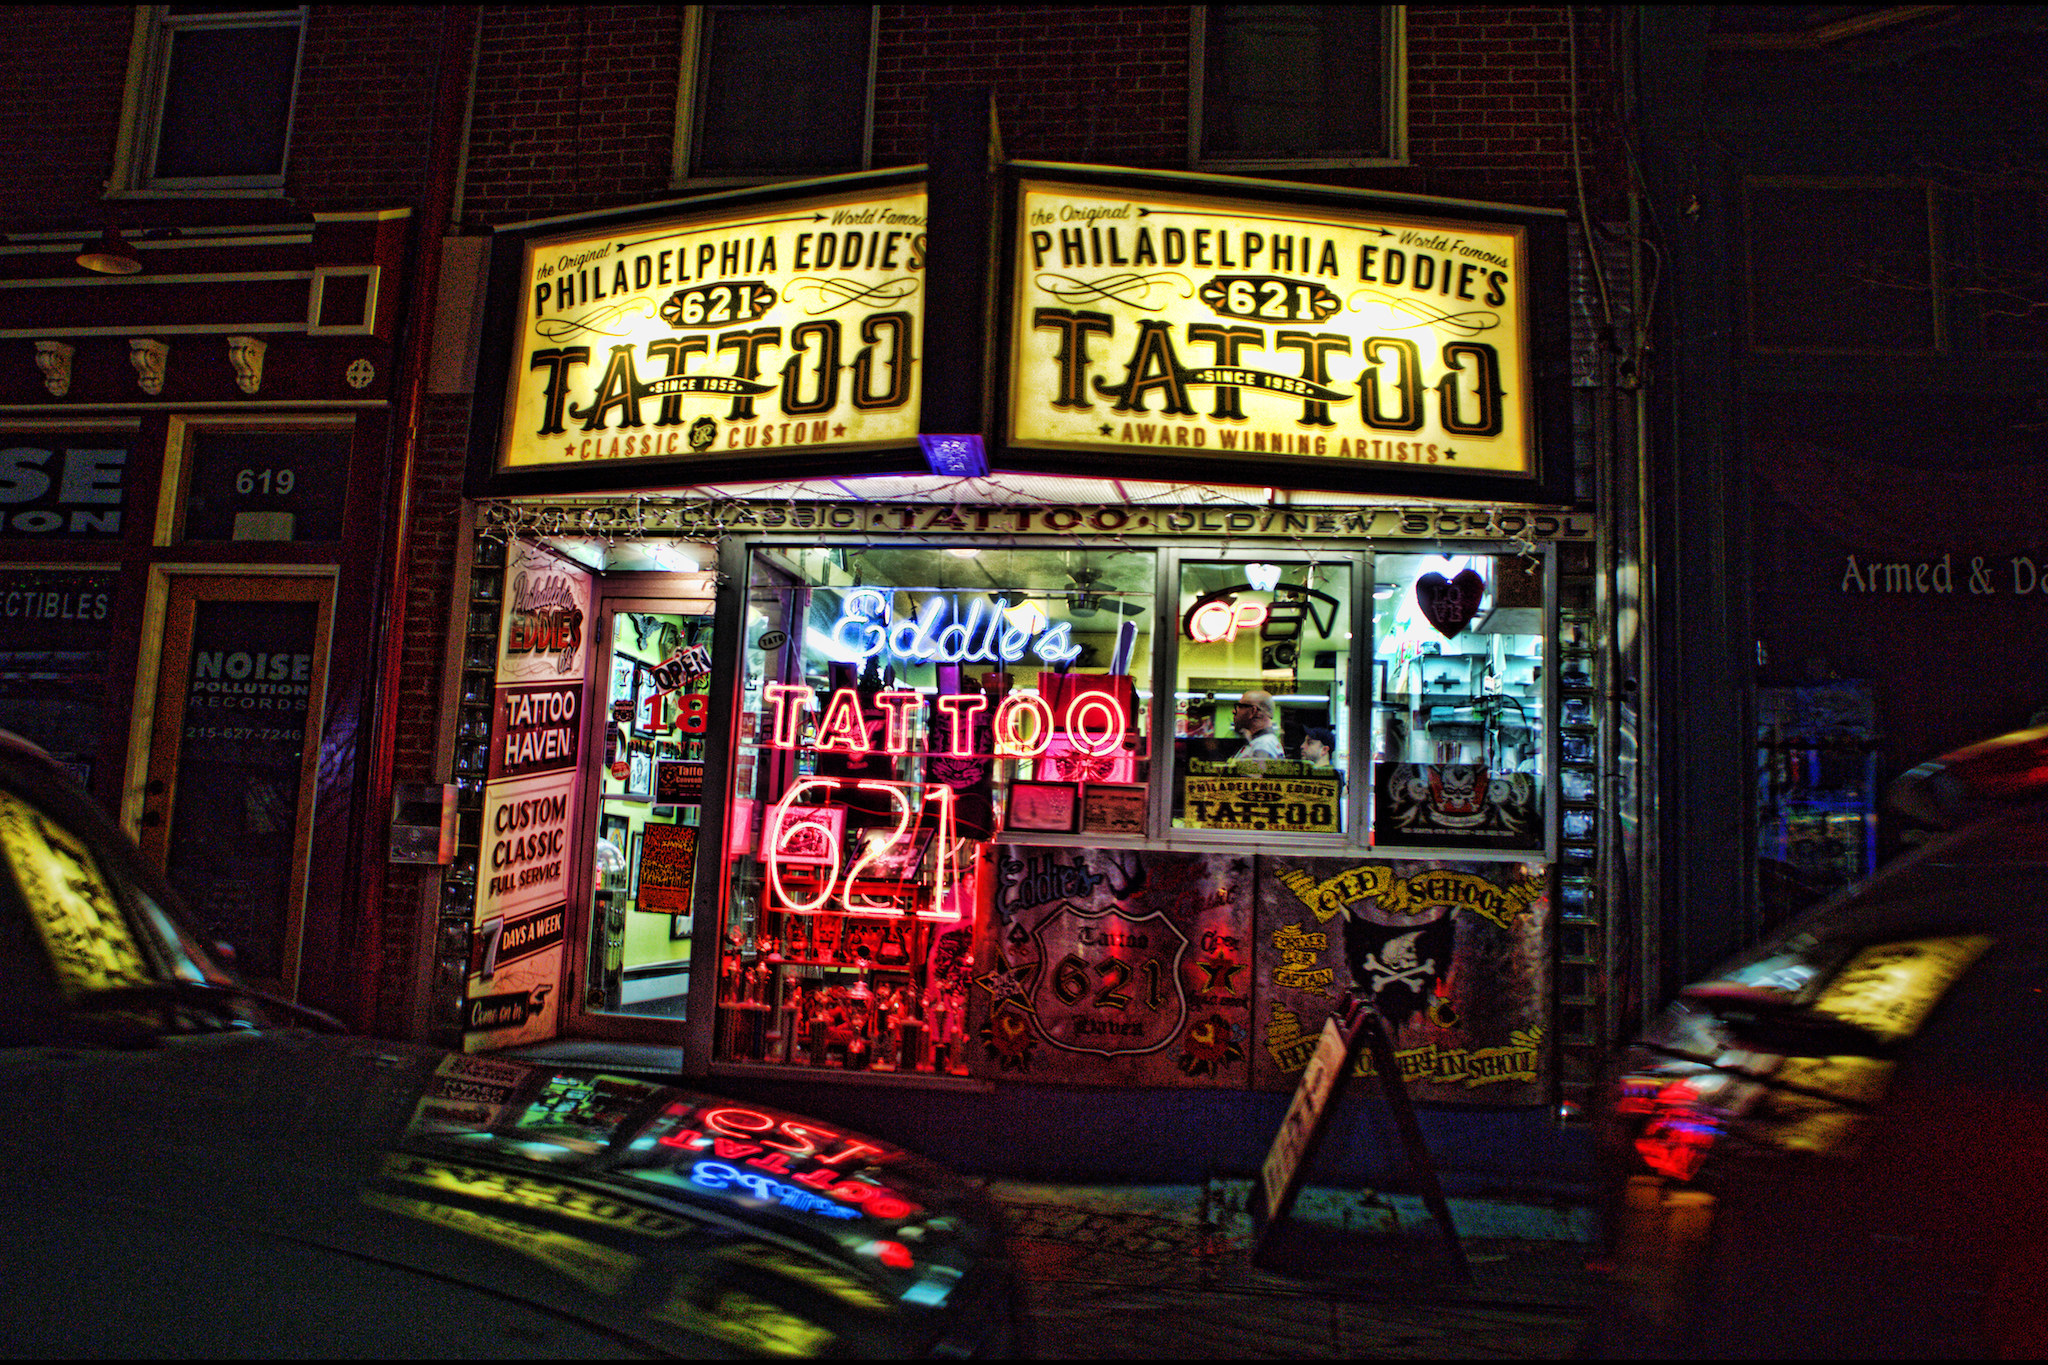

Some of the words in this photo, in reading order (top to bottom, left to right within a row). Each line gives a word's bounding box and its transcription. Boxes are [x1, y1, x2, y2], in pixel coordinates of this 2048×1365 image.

[832, 208, 879, 225] World
[1030, 208, 1056, 226] the
[1059, 202, 1131, 228] Original
[536, 263, 555, 281] the
[558, 241, 612, 273] Original
[1031, 226, 1341, 280] PHILADELPHIA
[1358, 245, 1510, 309] EDDIE'S
[1398, 229, 1448, 254] World
[1450, 237, 1510, 269] Famous
[535, 235, 778, 319] PHILADELPHIA
[793, 230, 927, 273] EDDIE'S
[682, 286, 753, 325] 621
[1227, 280, 1316, 321] 621
[530, 310, 920, 440] TATTOO
[655, 379, 697, 394] SINCE
[703, 379, 738, 392] 1952
[1032, 306, 1508, 441] TATTOO
[1204, 370, 1257, 385] SINCE
[1264, 375, 1307, 393] 1952
[580, 431, 679, 460] CLASSIC
[727, 420, 830, 450] CUSTOM
[1120, 420, 1207, 450] AWARD
[1219, 428, 1328, 457] WINNING
[1339, 437, 1439, 467] ARTISTS
[235, 468, 296, 495] 619
[888, 506, 1130, 531] TATTOO
[1401, 512, 1590, 538] SCHOOL
[1841, 554, 1954, 594] Armed
[1968, 556, 1996, 595] &
[761, 633, 785, 647] TATU
[1189, 598, 1339, 644] OPEN
[195, 651, 311, 682] NOISE
[655, 648, 712, 690] OPEN
[189, 696, 308, 711] RECORDS
[191, 681, 311, 696] POLLUTION
[507, 691, 576, 727] TATTOO
[643, 693, 710, 734] 18
[765, 685, 1126, 758] TATTOO
[504, 727, 570, 766] HAVEN
[495, 794, 567, 833] CUSTOM
[1189, 800, 1333, 826] TATTOO
[492, 828, 564, 869] CLASSIC
[771, 780, 961, 920] 621
[489, 874, 517, 897] FULL
[518, 861, 562, 889] SERVICE
[1319, 870, 1379, 911] OLD
[481, 917, 504, 980] 7
[502, 927, 528, 951] DAYS
[527, 926, 535, 940] A
[536, 912, 562, 939] WEEK
[1054, 953, 1167, 1011] 621
